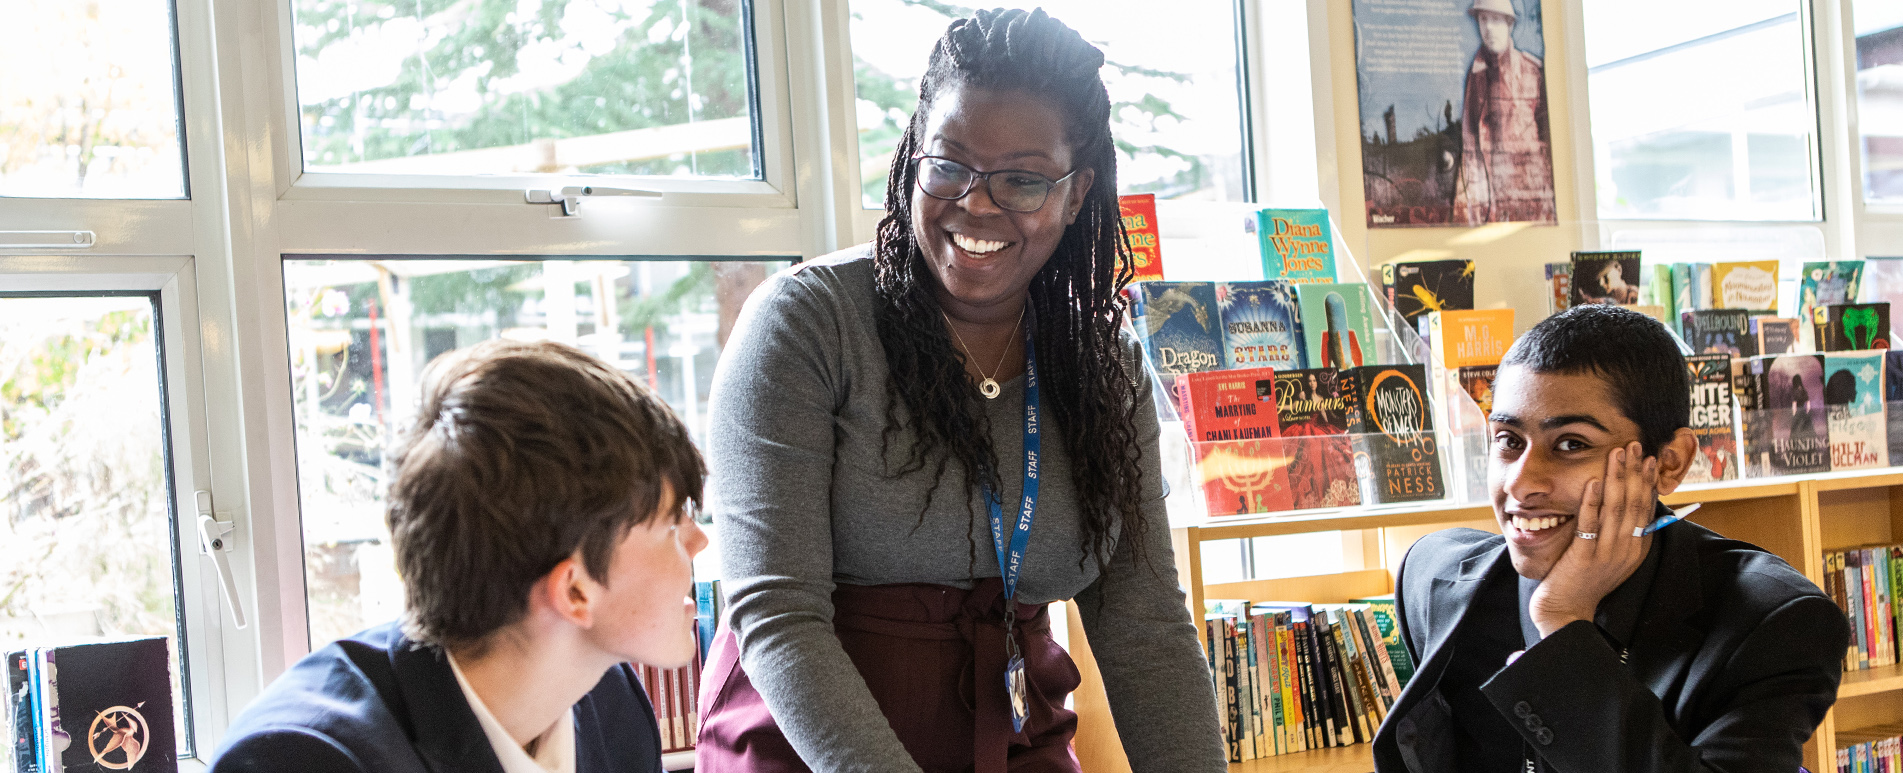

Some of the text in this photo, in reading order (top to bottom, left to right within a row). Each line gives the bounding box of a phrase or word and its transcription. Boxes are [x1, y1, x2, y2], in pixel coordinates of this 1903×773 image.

[1271, 217, 1322, 237] Diana
[1268, 235, 1329, 258] Wynne
[1280, 253, 1323, 276] Jones
[1228, 321, 1286, 334] SUSANNA
[1159, 347, 1218, 368] Dragon
[1234, 344, 1290, 363] STARS
[1457, 337, 1503, 359] HARRIS
[1027, 358, 1036, 388] STAFF
[1228, 381, 1246, 390] HARRIS
[1274, 378, 1344, 415] Rumours
[1690, 382, 1730, 405] HITE
[1215, 403, 1257, 418] MARRYING
[1227, 395, 1240, 404] The
[1340, 379, 1355, 427] NESS
[1348, 376, 1361, 424] PATRICK
[1375, 387, 1417, 420] MONSTERS
[1028, 404, 1037, 434] STAFF
[1234, 418, 1240, 427] of
[1382, 416, 1393, 434] OF
[1689, 404, 1731, 427] IGER
[1206, 430, 1232, 441] CHANI
[1233, 426, 1272, 440] KAUFMAN
[1392, 414, 1424, 448] MEN
[1773, 437, 1830, 454] HAUNTING
[1832, 441, 1866, 455] HILIP
[1028, 450, 1037, 479] STAFF
[1783, 452, 1822, 467] VIOLET
[1832, 452, 1878, 467] ULLMAN
[1387, 466, 1432, 477] PATRICK
[1388, 476, 1435, 494] NESS
[1019, 496, 1034, 531] STAFF
[992, 517, 1003, 552] STAFF
[1007, 550, 1021, 586] STAFF
[1339, 616, 1354, 652] JANE ELSON
[1224, 621, 1234, 678] BAD
[1266, 617, 1281, 694] THE BUBBLE WRAP BOY
[1376, 641, 1389, 664] ROOTS
[1362, 652, 1373, 680] California
[1273, 697, 1282, 716] PHIL
